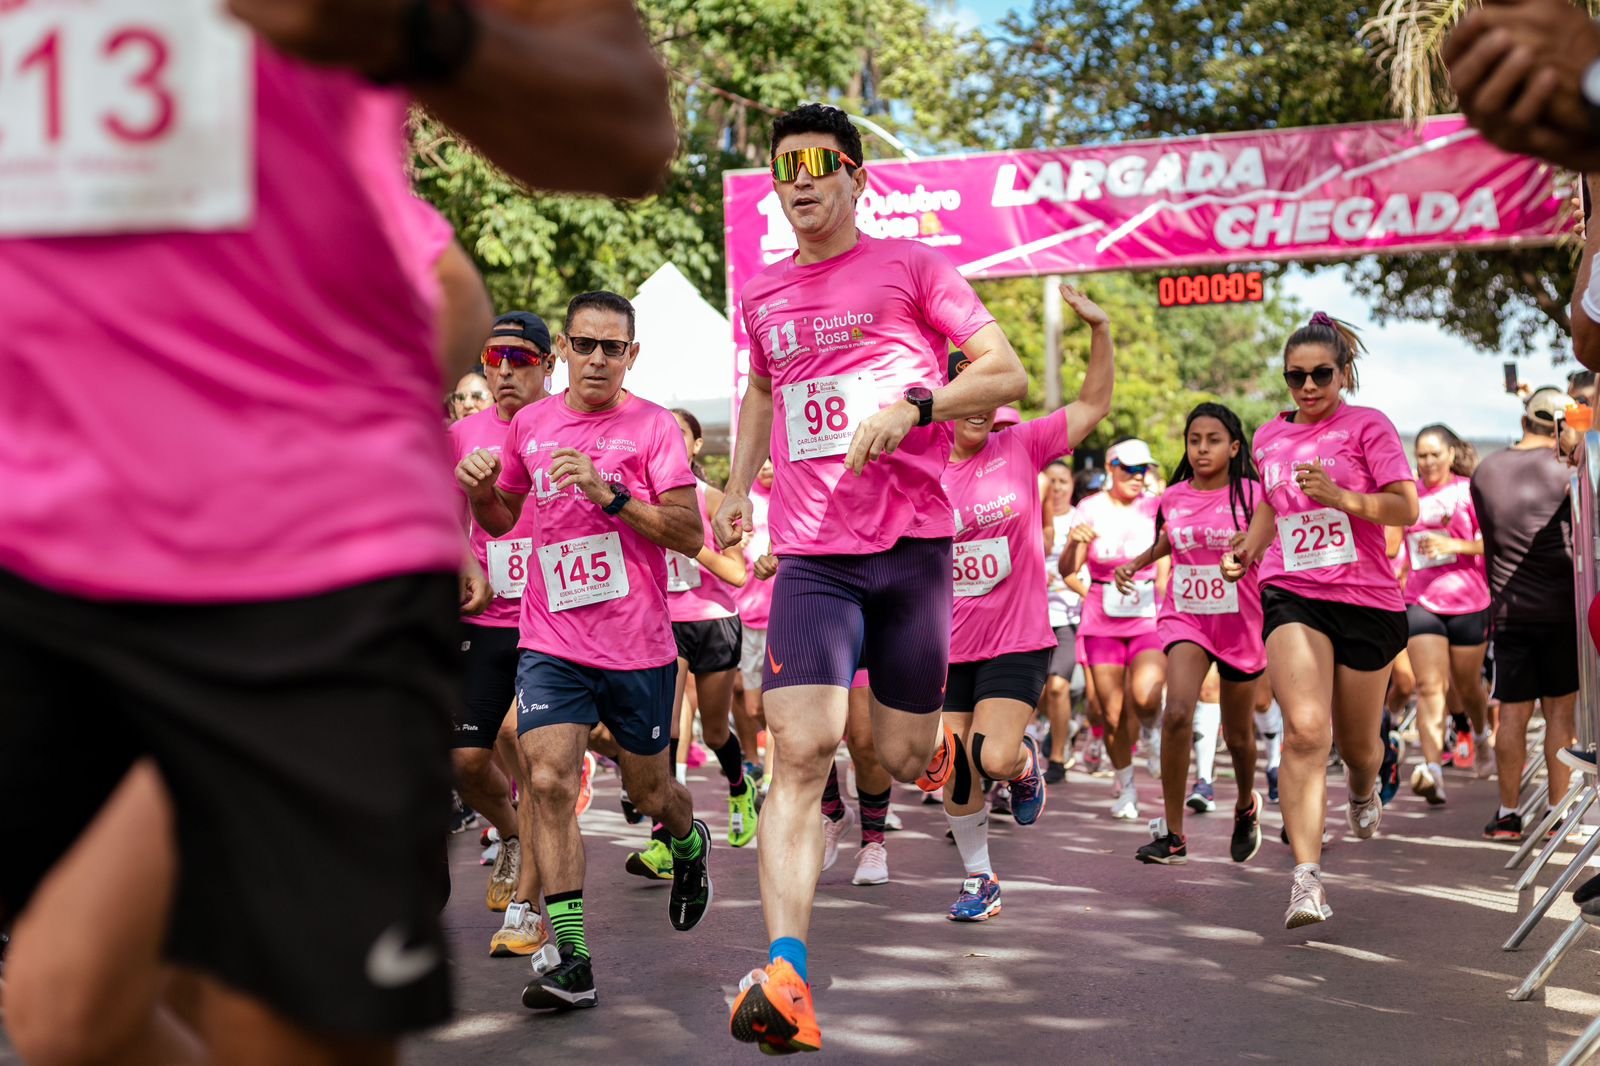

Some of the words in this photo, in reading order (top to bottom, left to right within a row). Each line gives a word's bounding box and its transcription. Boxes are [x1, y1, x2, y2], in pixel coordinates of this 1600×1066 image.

[0, 26, 177, 145] 13
[991, 147, 1267, 207] LARGADA
[1213, 187, 1500, 249] CHEGADA
[813, 310, 874, 332] Outubro
[814, 330, 850, 346] Rosa
[804, 395, 849, 436] 98
[797, 436, 818, 446] CARLOS
[818, 431, 854, 442] ALBUQUER
[973, 492, 1017, 515] Outubro
[976, 510, 1005, 526] Rosa
[1291, 521, 1346, 554] 225
[553, 551, 611, 590] 145
[586, 582, 610, 592] FREITAS
[1182, 578, 1225, 600] 208
